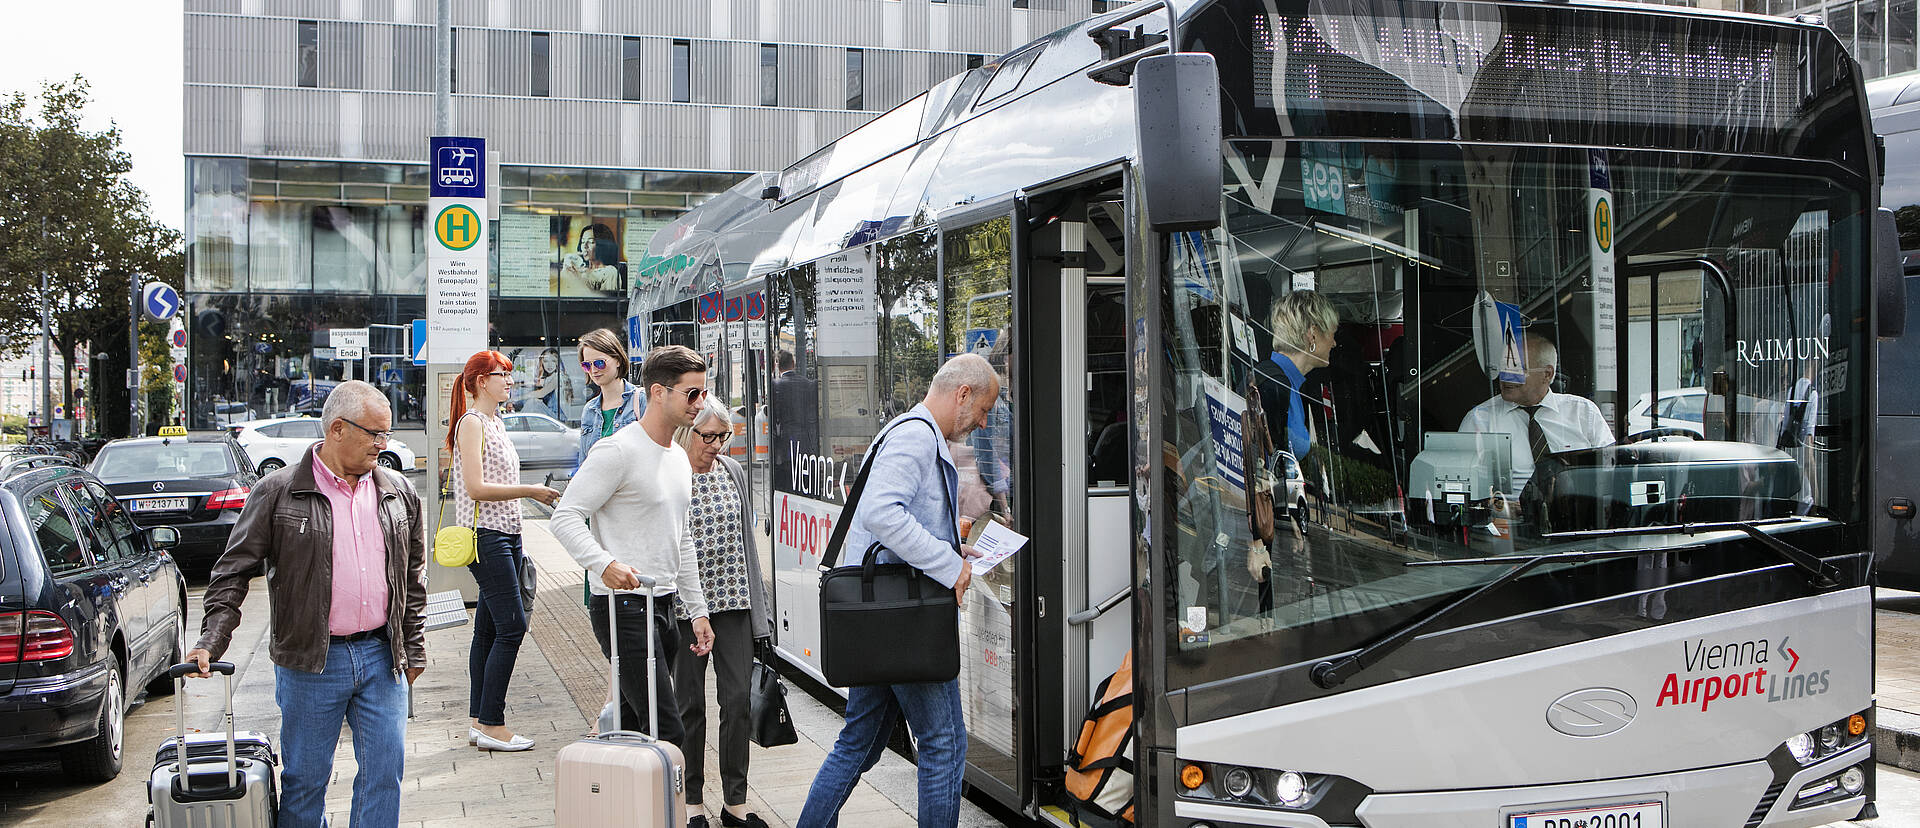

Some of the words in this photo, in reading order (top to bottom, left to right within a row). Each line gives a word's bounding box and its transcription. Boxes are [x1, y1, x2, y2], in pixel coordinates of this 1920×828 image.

[1504, 34, 1772, 81] Westbahnhof
[447, 213, 469, 241] H
[1737, 336, 1830, 367] RAIMUN
[163, 427, 184, 435] TAXI
[790, 440, 835, 499] Vienna
[138, 501, 145, 509] W
[151, 500, 171, 508] 2137
[175, 499, 185, 507] TX
[779, 495, 832, 565] Airport
[1683, 639, 1769, 673] Vienna
